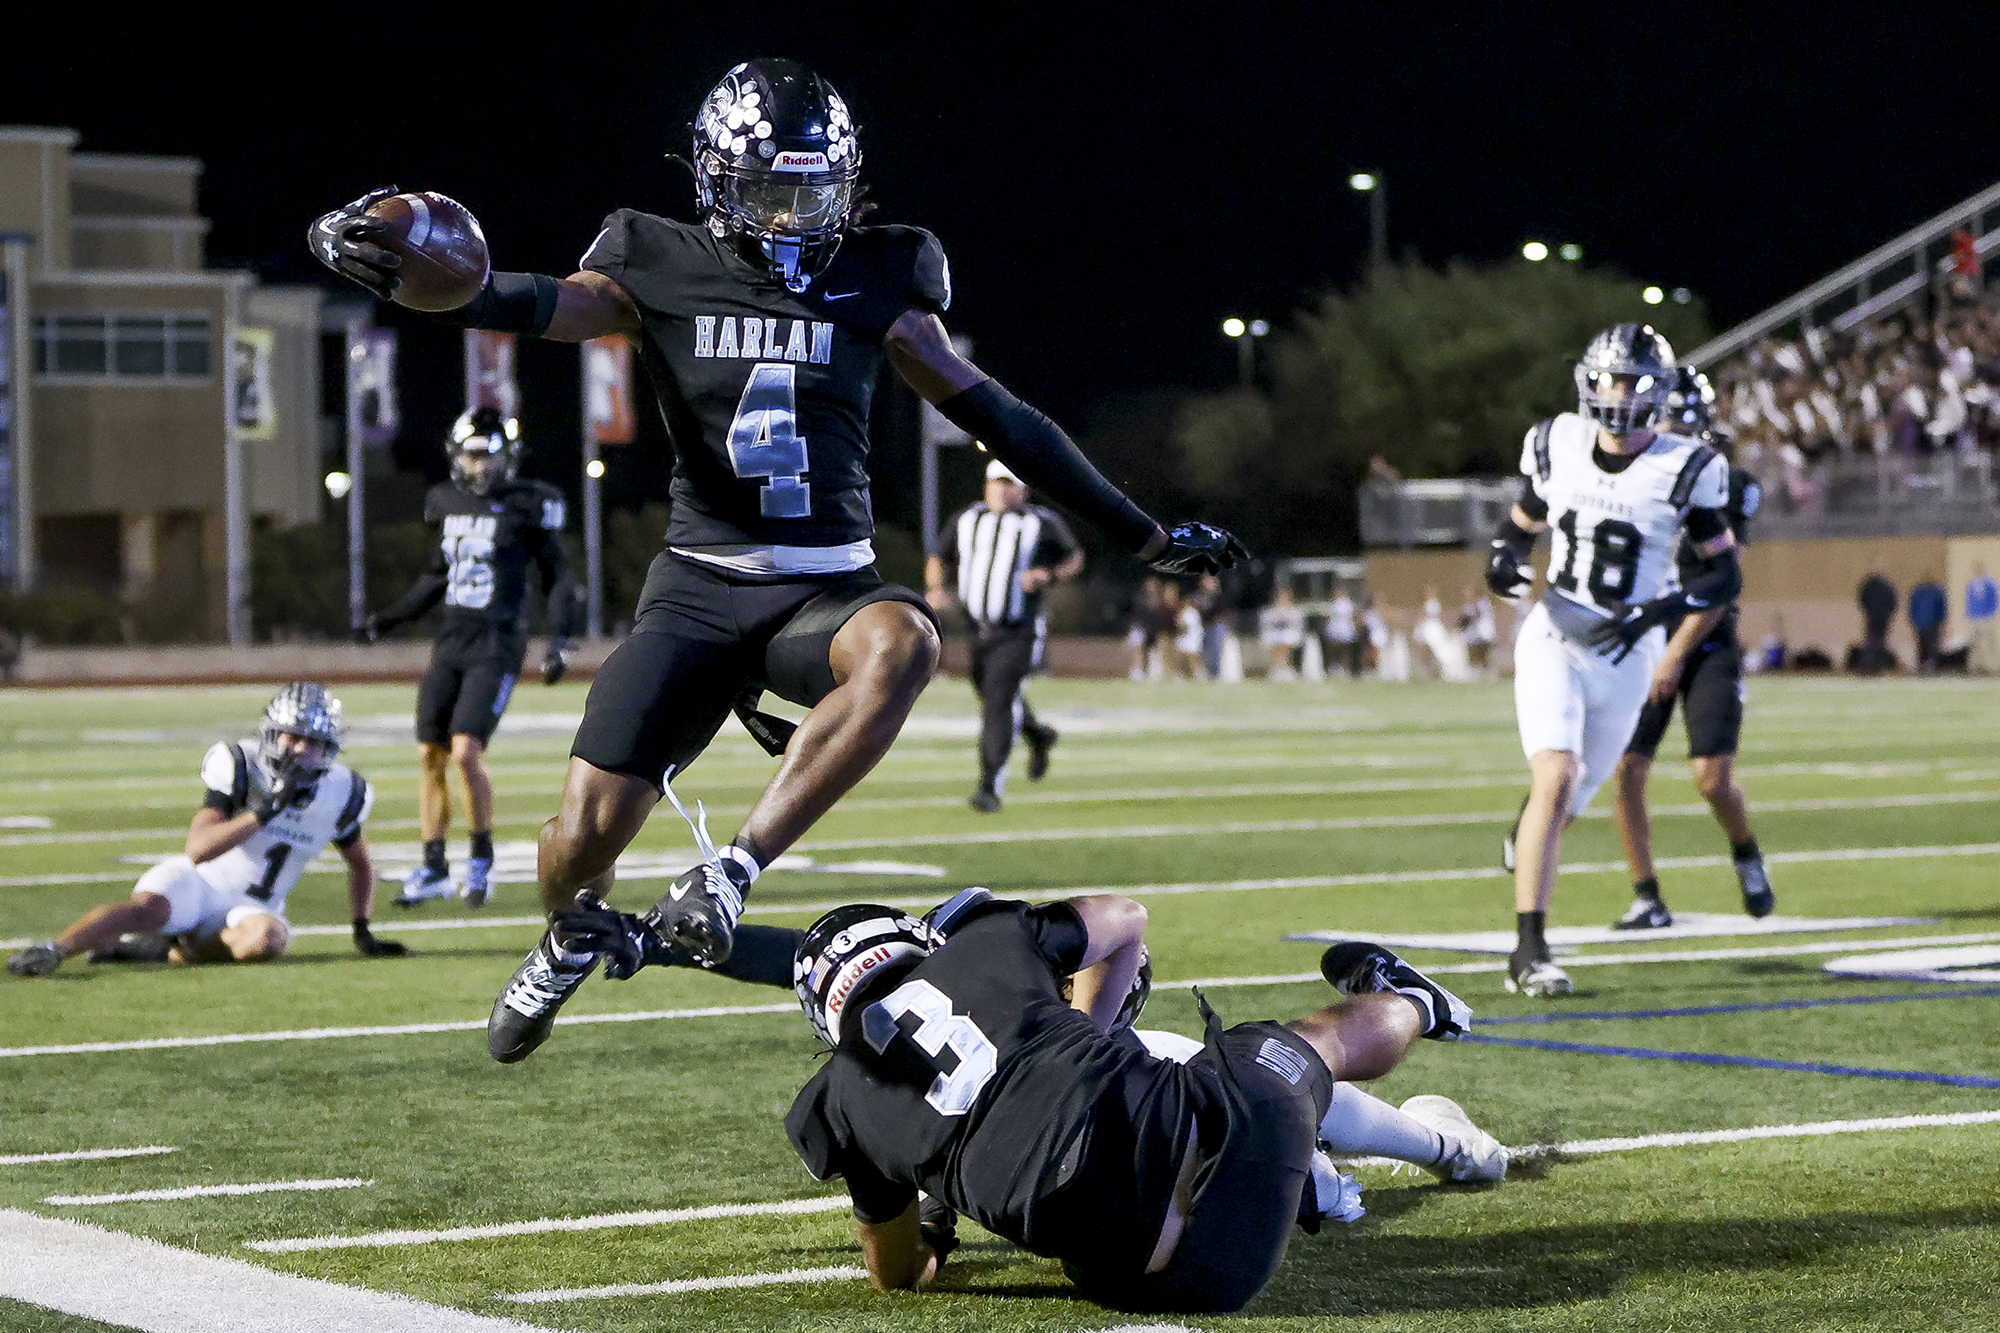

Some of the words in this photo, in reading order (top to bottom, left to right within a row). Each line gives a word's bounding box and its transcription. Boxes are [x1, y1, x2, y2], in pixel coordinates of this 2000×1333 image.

[782, 155, 823, 165] Riddell
[694, 315, 834, 365] HARLAN
[725, 362, 812, 518] 4
[1555, 507, 1644, 607] 18
[245, 841, 293, 902] 1
[839, 934, 852, 946] 3
[828, 947, 892, 1014] Riddell
[861, 978, 998, 1117] 3
